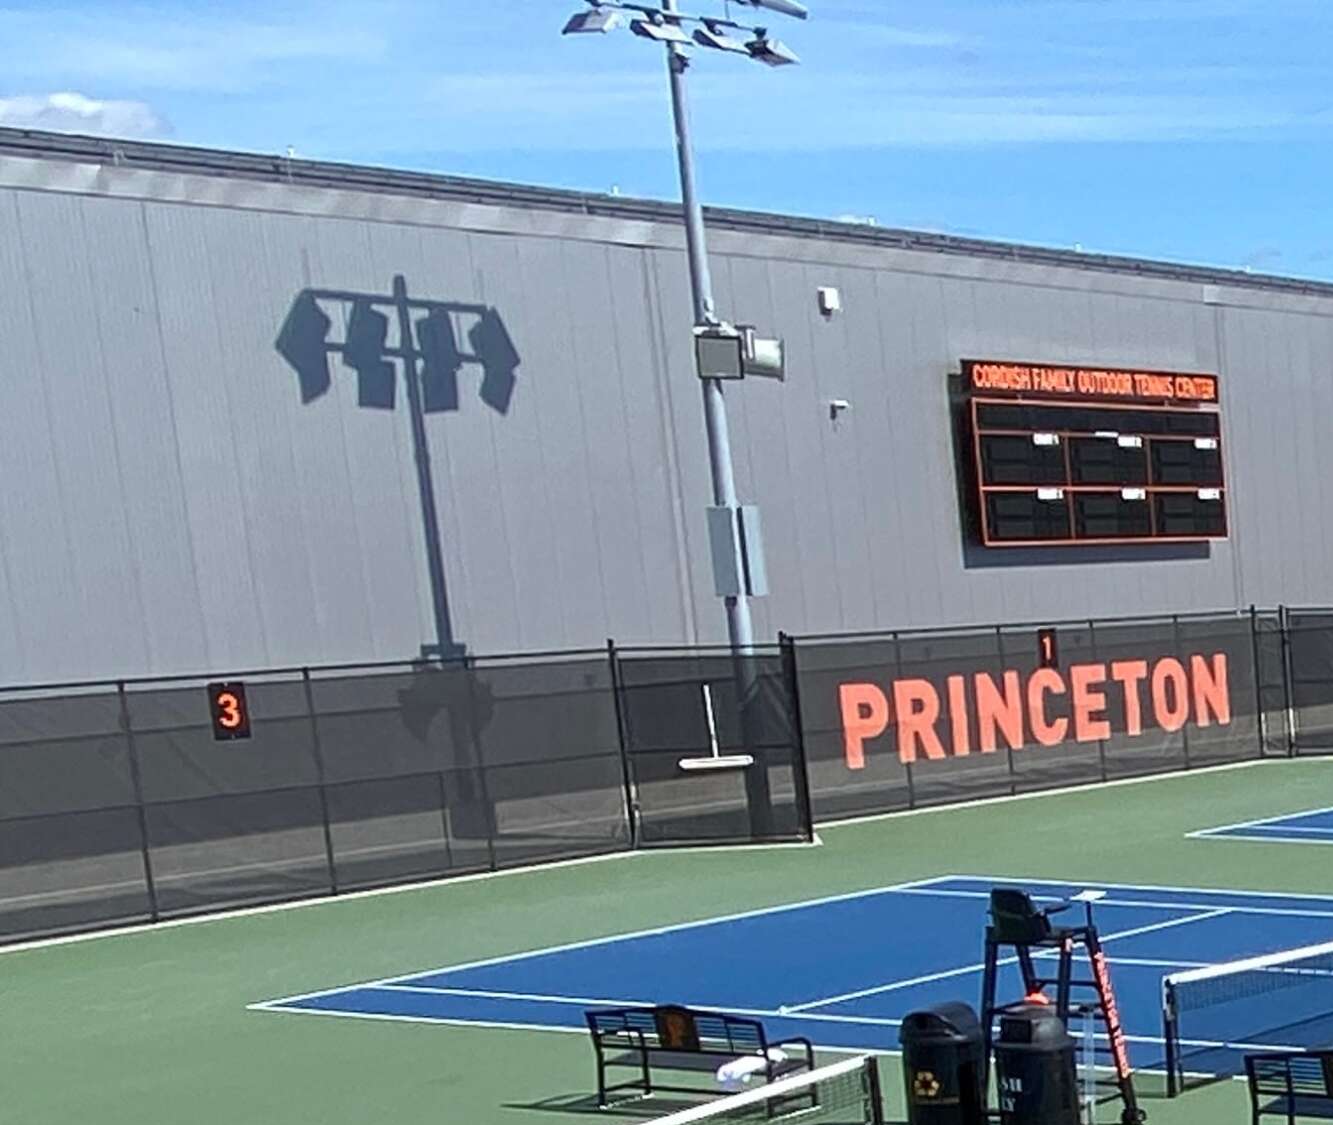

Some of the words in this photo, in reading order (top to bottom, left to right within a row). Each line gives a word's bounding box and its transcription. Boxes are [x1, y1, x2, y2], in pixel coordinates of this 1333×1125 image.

[973, 364, 1031, 391] CORDISH
[1032, 367, 1076, 393] FAMILY
[1078, 370, 1133, 395] OUTDOOR
[1134, 373, 1174, 397] TENNIS
[1175, 376, 1215, 400] CENTER
[1042, 635, 1052, 660] 1
[217, 693, 241, 727] 3
[839, 653, 1231, 769] PRINCETON
